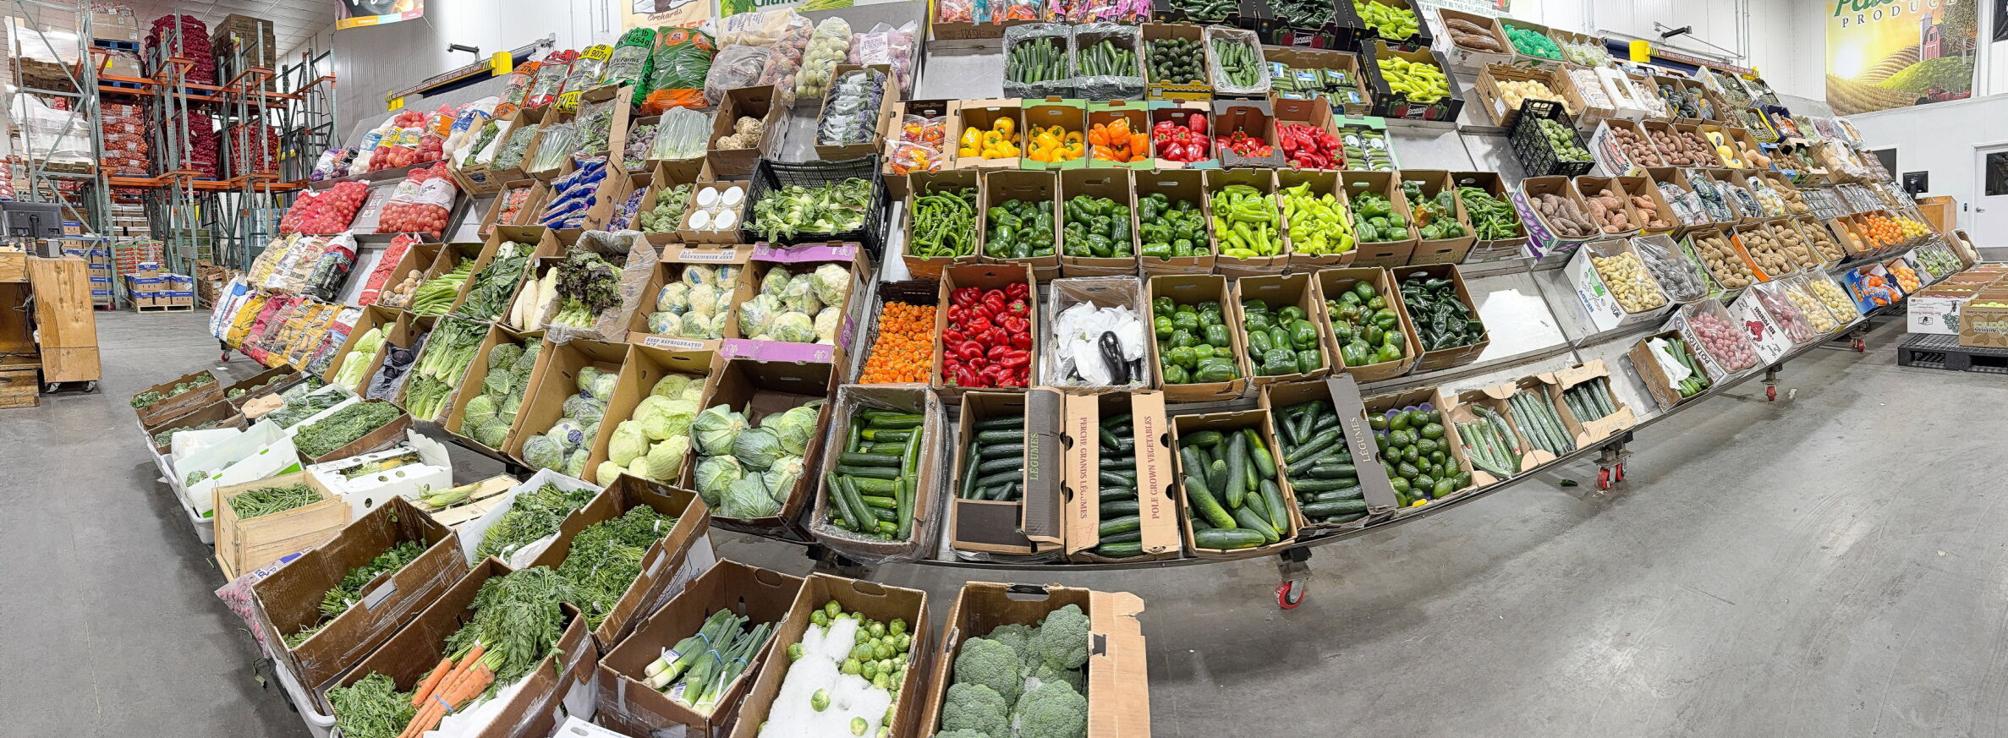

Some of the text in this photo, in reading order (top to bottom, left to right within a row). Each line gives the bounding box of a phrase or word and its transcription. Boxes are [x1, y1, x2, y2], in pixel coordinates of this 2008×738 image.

[647, 9, 683, 21] Orchards
[1684, 328, 1711, 364] POTATOES
[1029, 431, 1039, 481] LÉGUMES
[1352, 417, 1372, 464] LÉGUMES
[1079, 447, 1088, 479] GRANDS
[1144, 415, 1160, 520] POLE GROWN VEGETABLES
